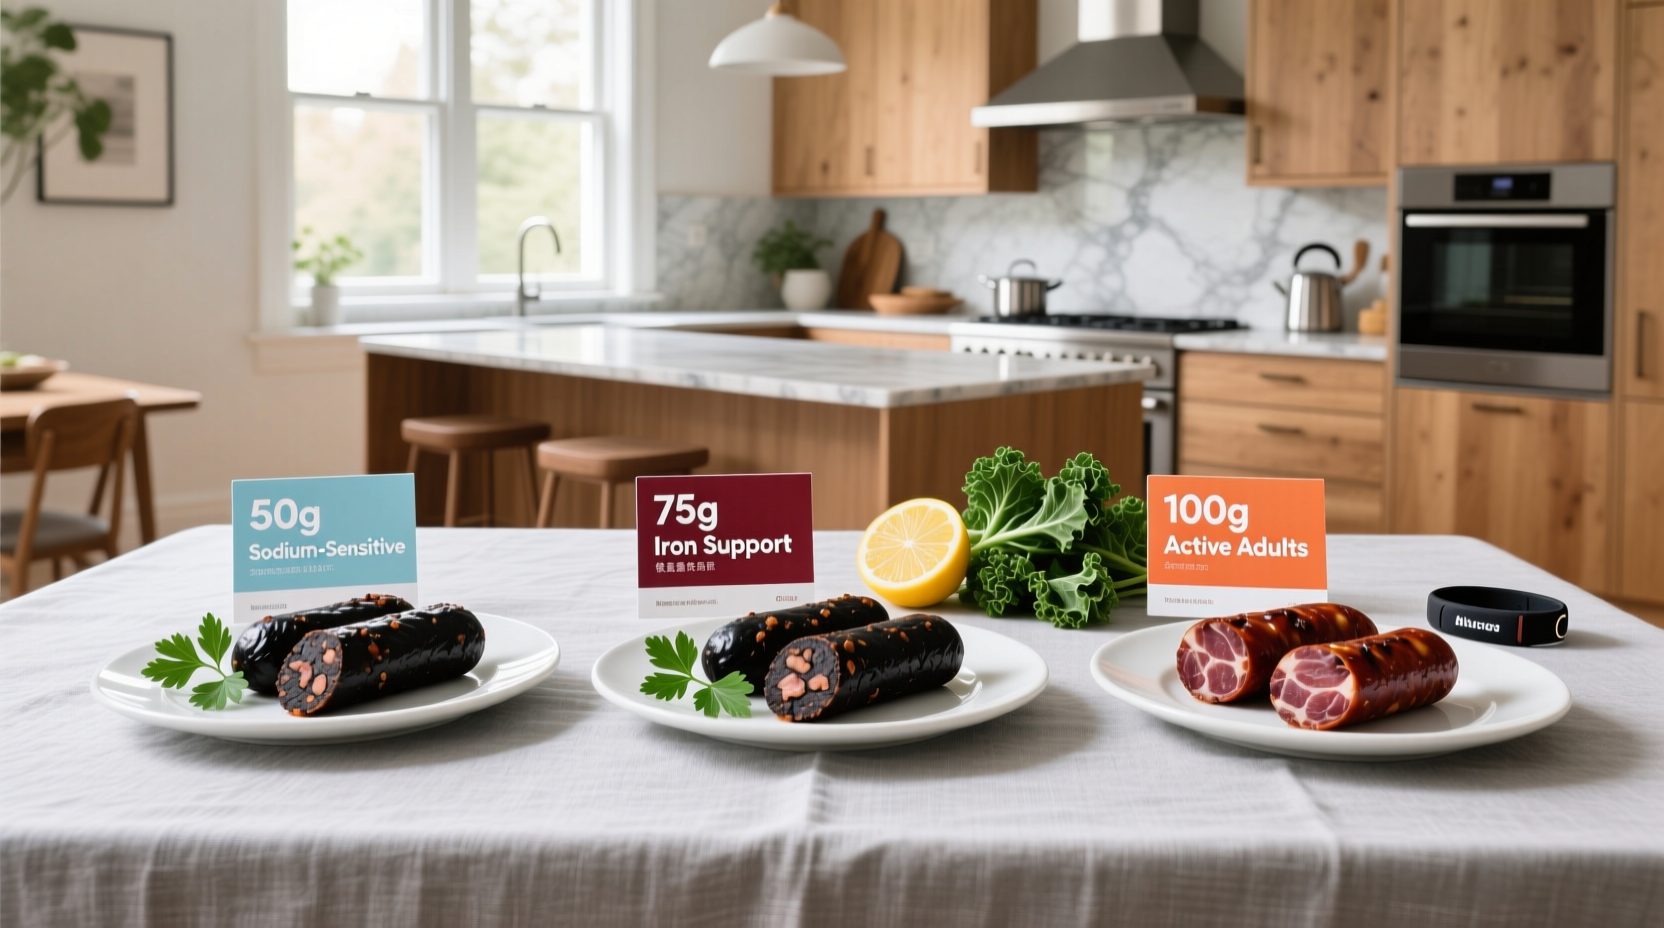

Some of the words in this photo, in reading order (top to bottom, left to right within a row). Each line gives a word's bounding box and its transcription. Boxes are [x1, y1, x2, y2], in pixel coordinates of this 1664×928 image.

[250, 498, 320, 536] 50g
[654, 494, 718, 532] 75g
[1163, 494, 1248, 533] 100g
[249, 537, 406, 560] Sodium-Sensitive
[654, 536, 697, 556] Iron
[703, 534, 792, 559] Support
[1163, 535, 1232, 556] Active
[1237, 536, 1309, 557] Adults
